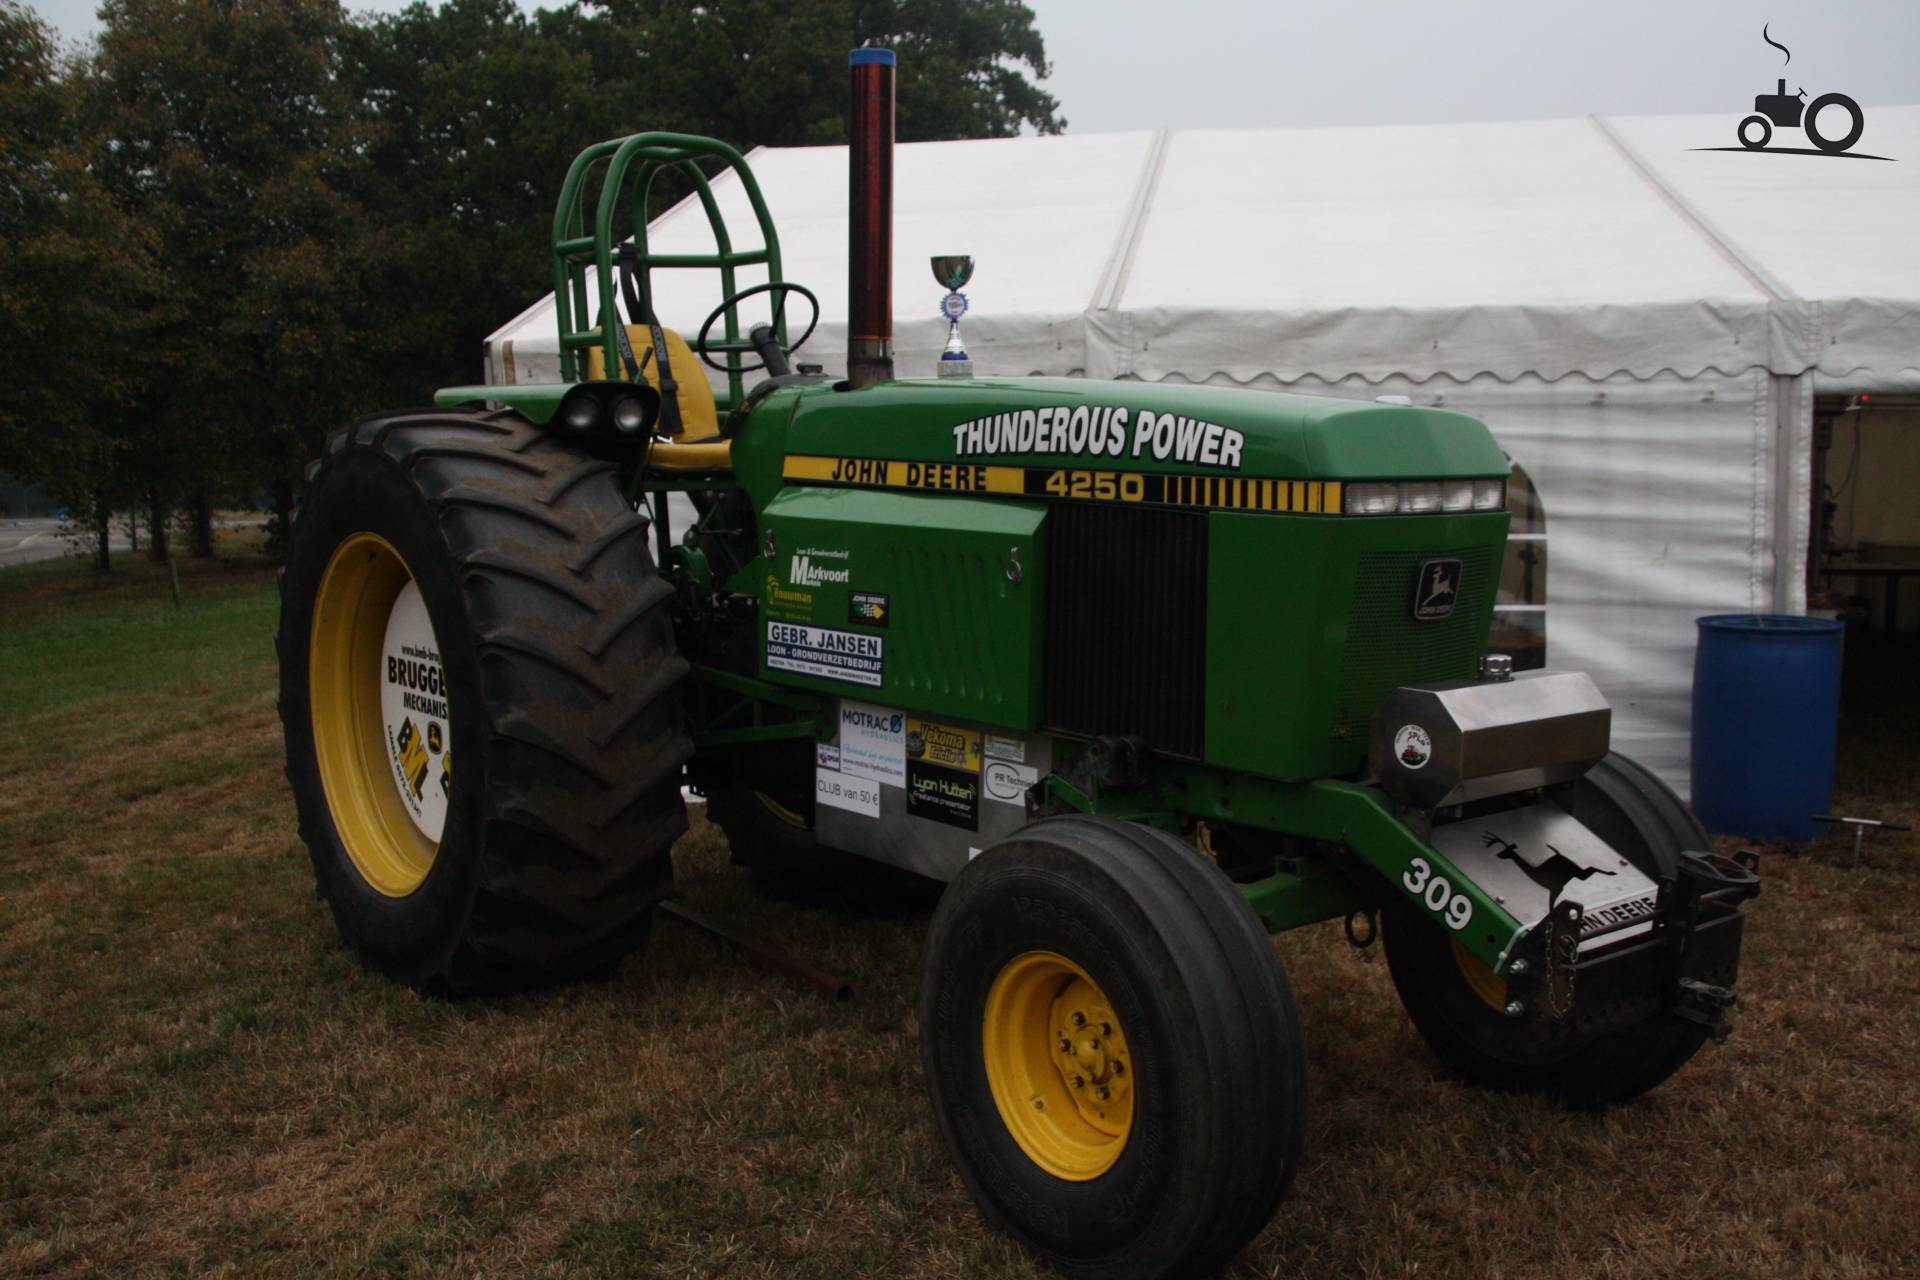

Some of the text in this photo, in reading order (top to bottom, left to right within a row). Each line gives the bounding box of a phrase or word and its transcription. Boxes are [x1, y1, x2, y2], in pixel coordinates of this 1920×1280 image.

[953, 405, 1245, 468] THUNDEROUS POWER
[831, 459, 987, 490] JOHN DEERE
[1046, 470, 1145, 501] 4250
[771, 625, 878, 656] GEBR. JANSEN
[767, 644, 786, 655] LOON
[792, 648, 882, 672] GRONDVERZETBEDRIJF
[842, 709, 888, 732] MOTRAC
[920, 725, 965, 750] Vekoma
[817, 779, 879, 806] CLUB van 50 €
[912, 771, 938, 792] Lyon
[939, 778, 972, 800] Hutten
[994, 772, 1004, 783] PR
[1403, 857, 1473, 930] 309
[1580, 897, 1657, 932] HN DEERE
